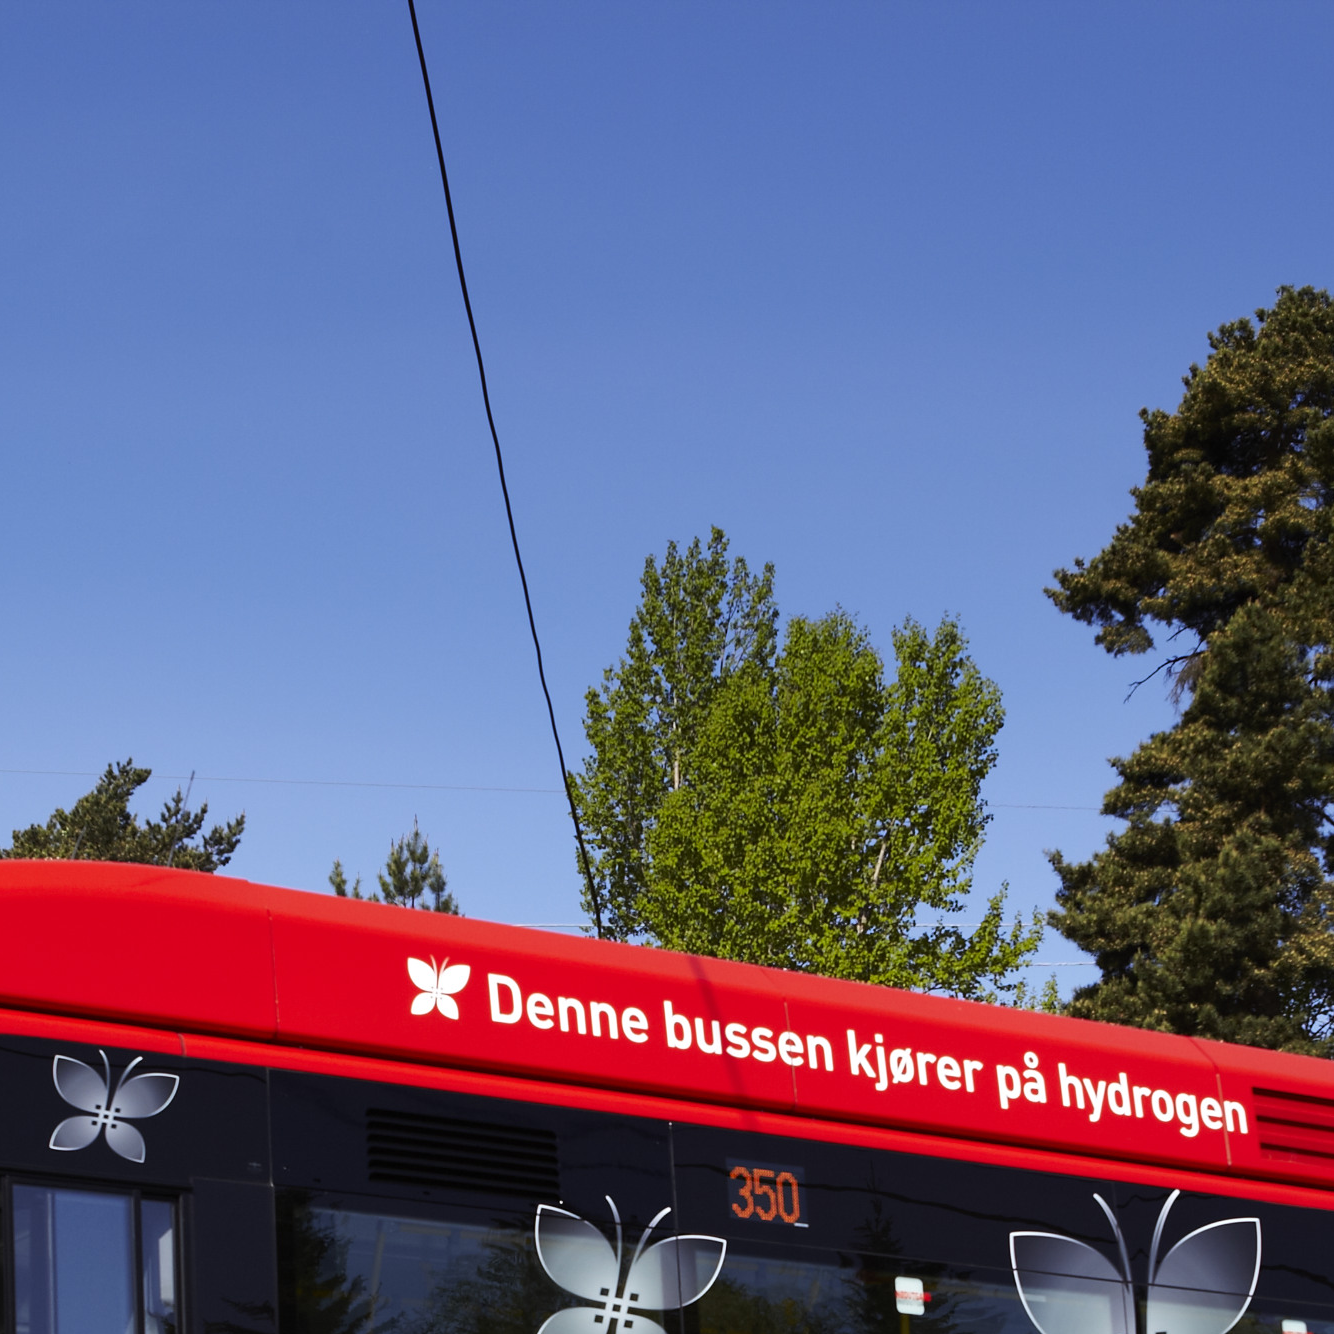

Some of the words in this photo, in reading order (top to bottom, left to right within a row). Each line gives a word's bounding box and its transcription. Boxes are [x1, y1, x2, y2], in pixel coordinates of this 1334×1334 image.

[487, 972, 649, 1044] Denne
[664, 999, 834, 1072] bussen
[847, 1028, 984, 1092] kjører
[996, 1051, 1048, 1110] på
[1058, 1062, 1249, 1138] hydrogen
[729, 1166, 800, 1223] 350
